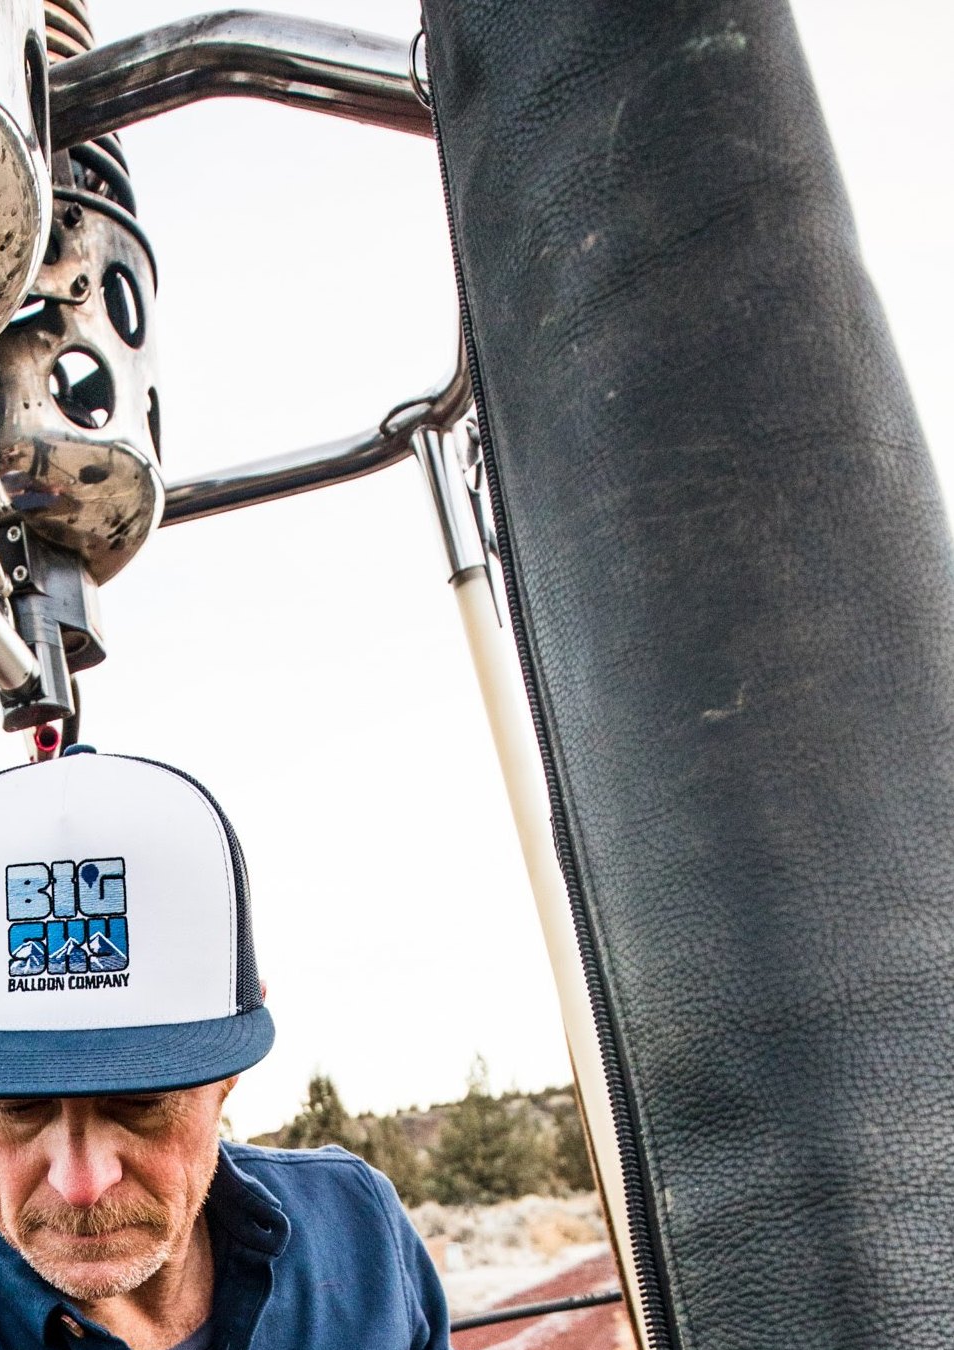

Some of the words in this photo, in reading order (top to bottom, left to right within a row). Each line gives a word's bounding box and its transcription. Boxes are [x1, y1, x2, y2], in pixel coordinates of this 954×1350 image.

[6, 857, 127, 921] BIG
[8, 916, 129, 977] SKY
[8, 977, 64, 992] BALLOON
[68, 973, 130, 990] COMPANY
